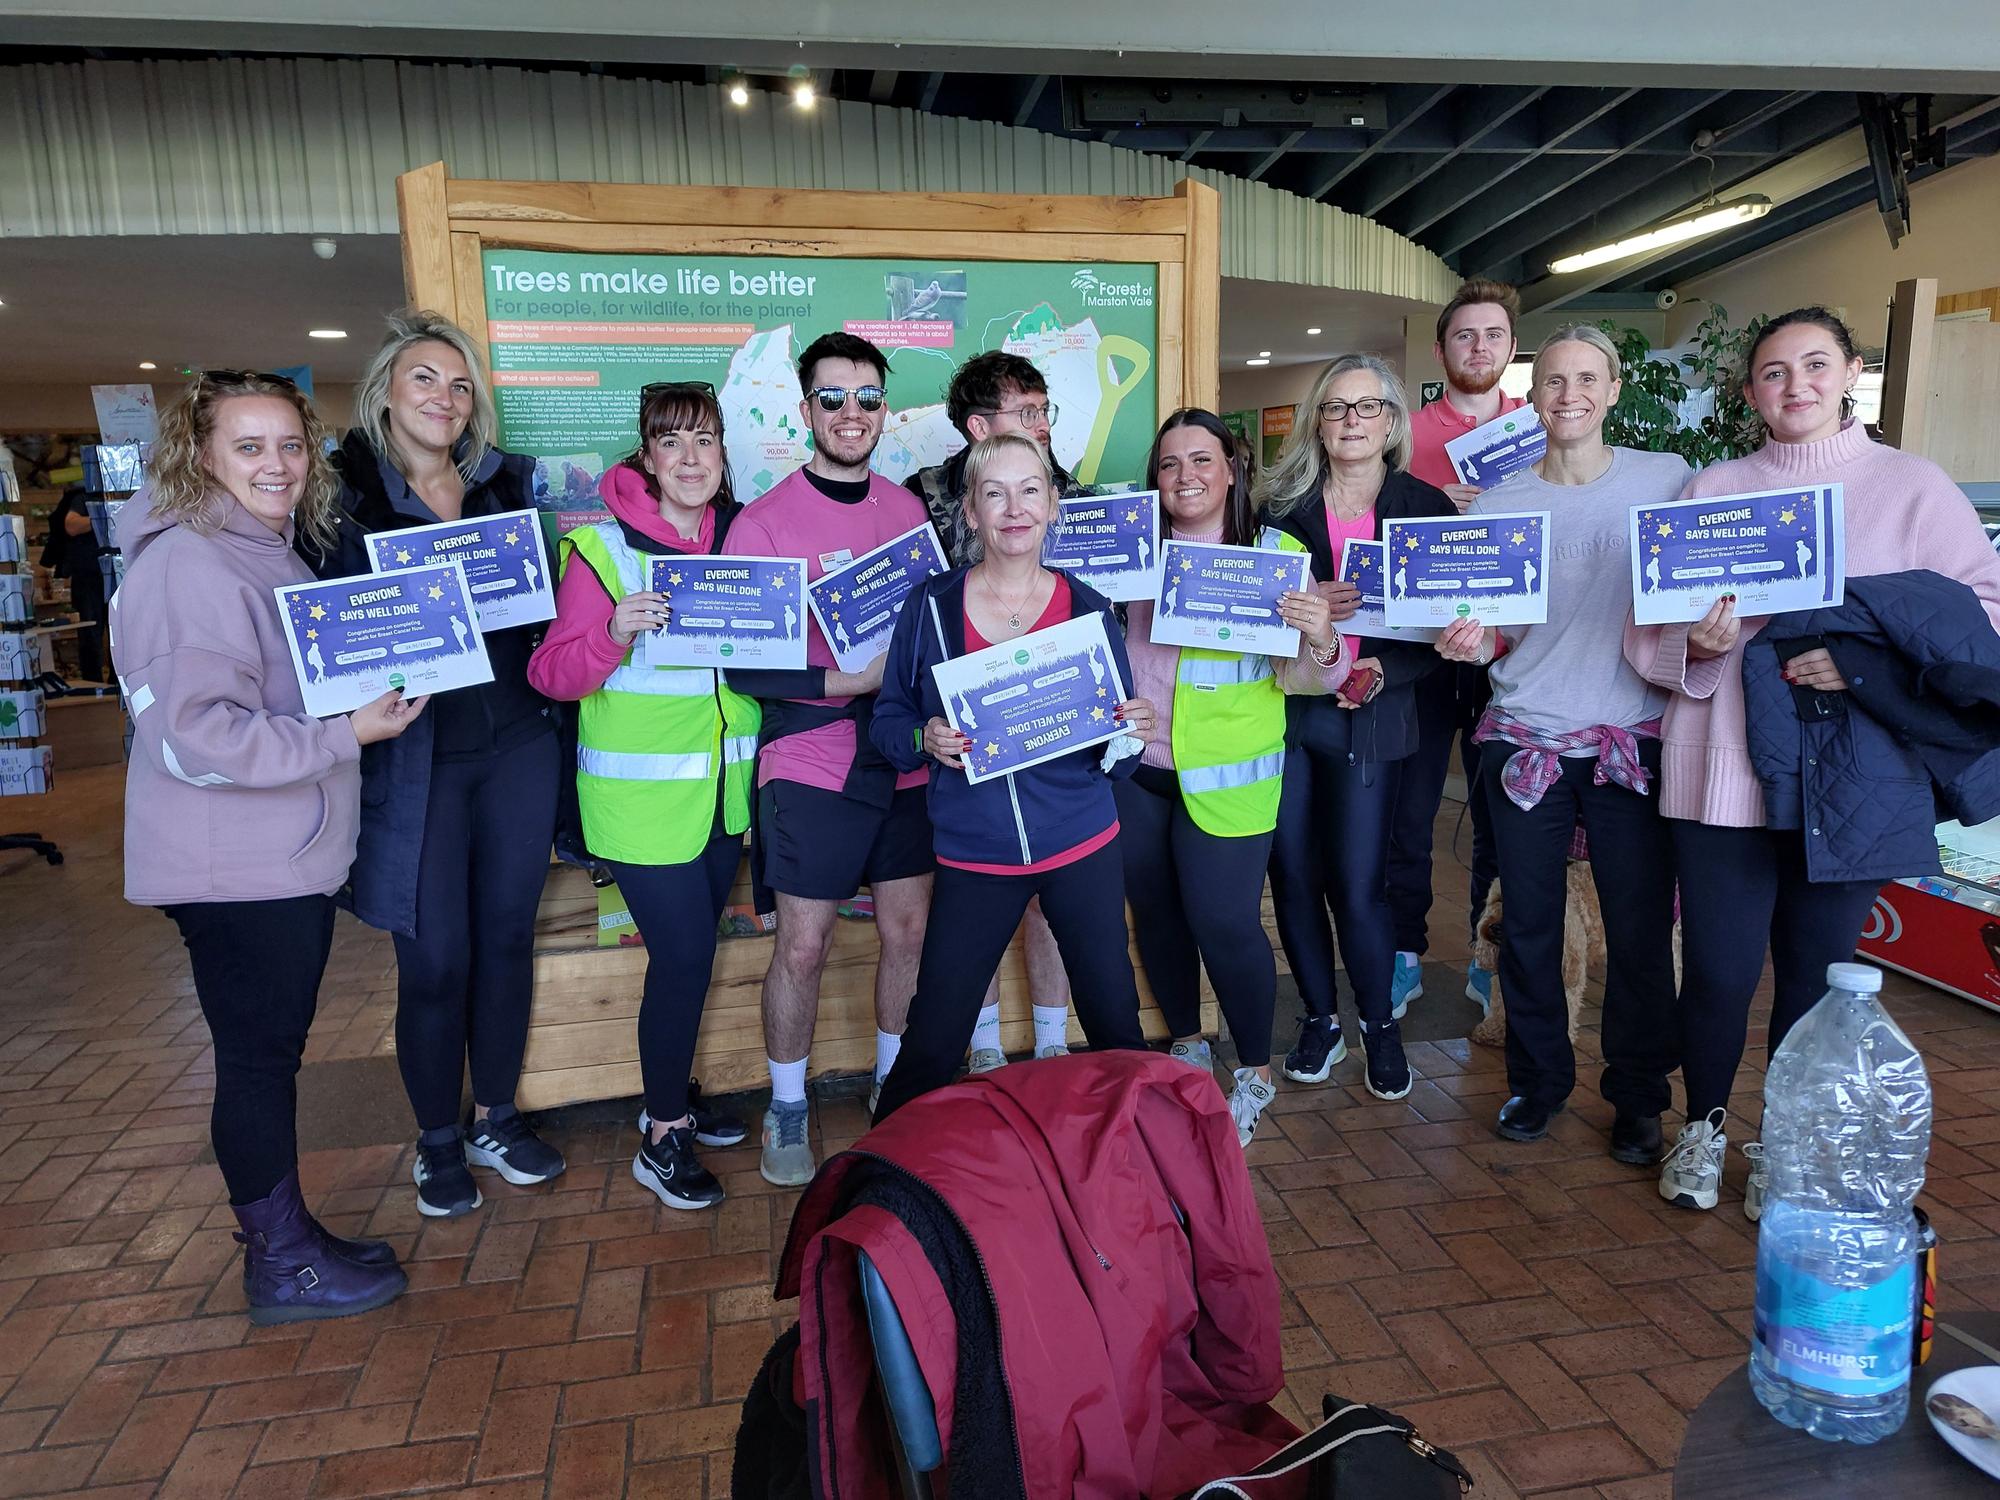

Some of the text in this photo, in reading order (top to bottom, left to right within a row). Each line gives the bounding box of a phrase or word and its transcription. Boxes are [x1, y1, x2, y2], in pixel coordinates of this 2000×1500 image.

[491, 265, 816, 297] Trees make life better
[1100, 282, 1152, 296] Forest of
[495, 298, 812, 318] For people, for wildlife, for the planet
[1088, 296, 1152, 306] Marston Vale
[497, 324, 523, 333] Planting
[523, 324, 540, 332] trees
[541, 324, 554, 332] and
[556, 325, 572, 333] using
[676, 326, 698, 334] people
[1064, 338, 1084, 346] 10,000
[1066, 509, 1105, 523] EVERYONE
[1699, 508, 1751, 526] EVERYONE
[1055, 525, 1116, 534] SAYS WELL DONE
[1442, 528, 1488, 542] EVERYONE
[1686, 527, 1766, 539] SAYS WELL DONE
[433, 532, 481, 551] EVERYONE
[424, 549, 496, 565] SAYS WELL DONE
[1430, 545, 1500, 555] SAYS WELL DONE
[473, 563, 497, 571] completing
[856, 557, 892, 584] EVERYONE
[1214, 559, 1254, 569] EVERYONE
[705, 570, 750, 580] EVERYONE
[1201, 569, 1263, 586] SAYS WELL DONE
[694, 582, 762, 596] SAYS WELL DONE
[851, 568, 907, 599] SAYS WELL DONE
[349, 586, 402, 607] EVERYONE
[340, 604, 420, 622] SAYS WELL DONE
[347, 625, 385, 637] Congratulations
[394, 620, 420, 629] completing
[346, 637, 357, 645] your
[1006, 708, 1078, 736] SAYS WELL DONE
[1024, 726, 1071, 752] EVERYONE
[1782, 1339, 1879, 1370] ELMHURST
